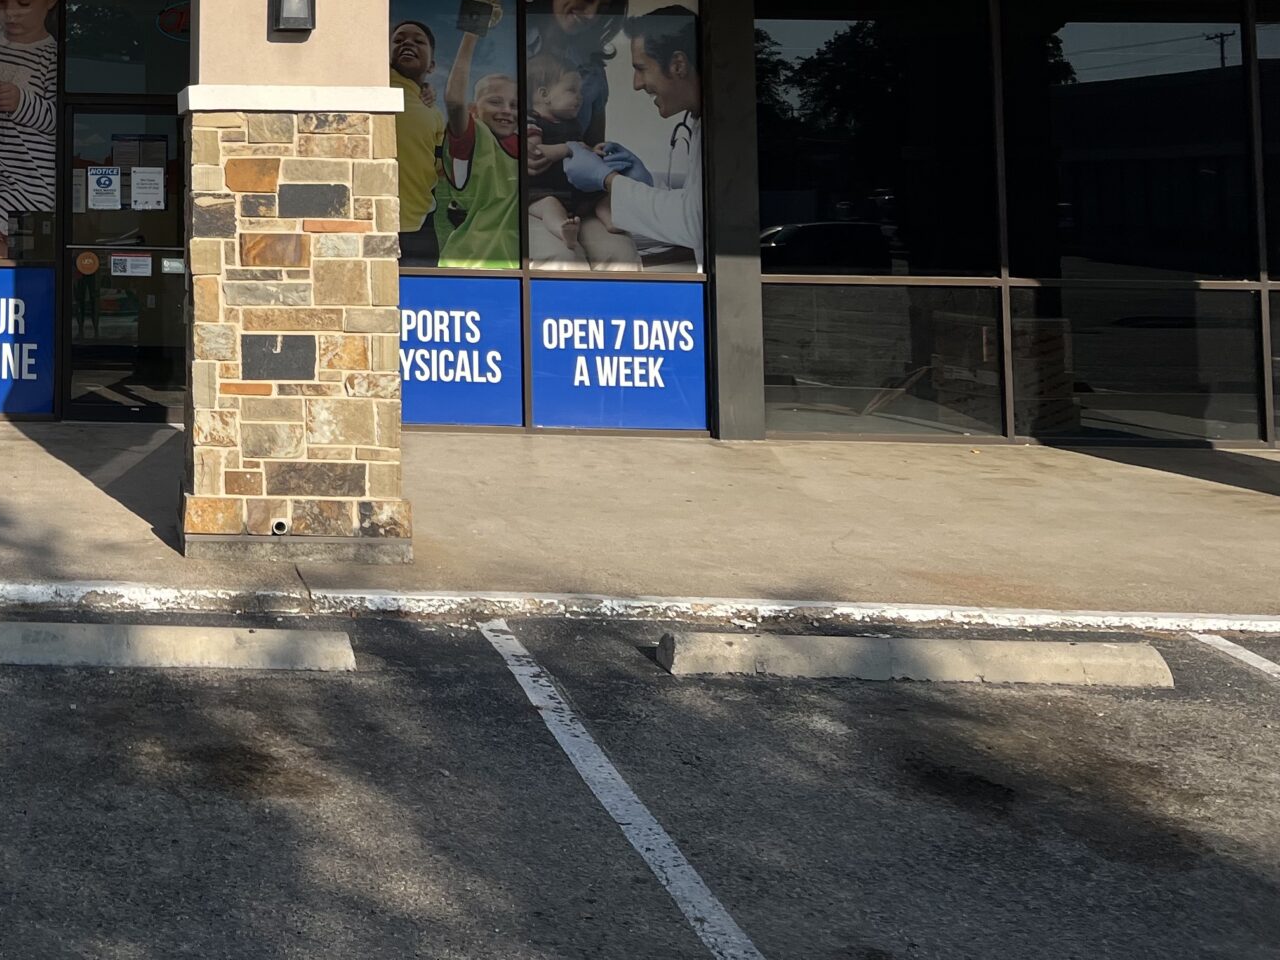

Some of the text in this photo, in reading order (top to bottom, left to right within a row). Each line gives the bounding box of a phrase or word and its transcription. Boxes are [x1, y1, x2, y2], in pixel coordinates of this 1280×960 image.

[401, 309, 481, 344] PORTS
[542, 318, 694, 352] OPEN 7 DAYS
[399, 349, 502, 384] YSICALS
[573, 356, 666, 388] A WEEK
